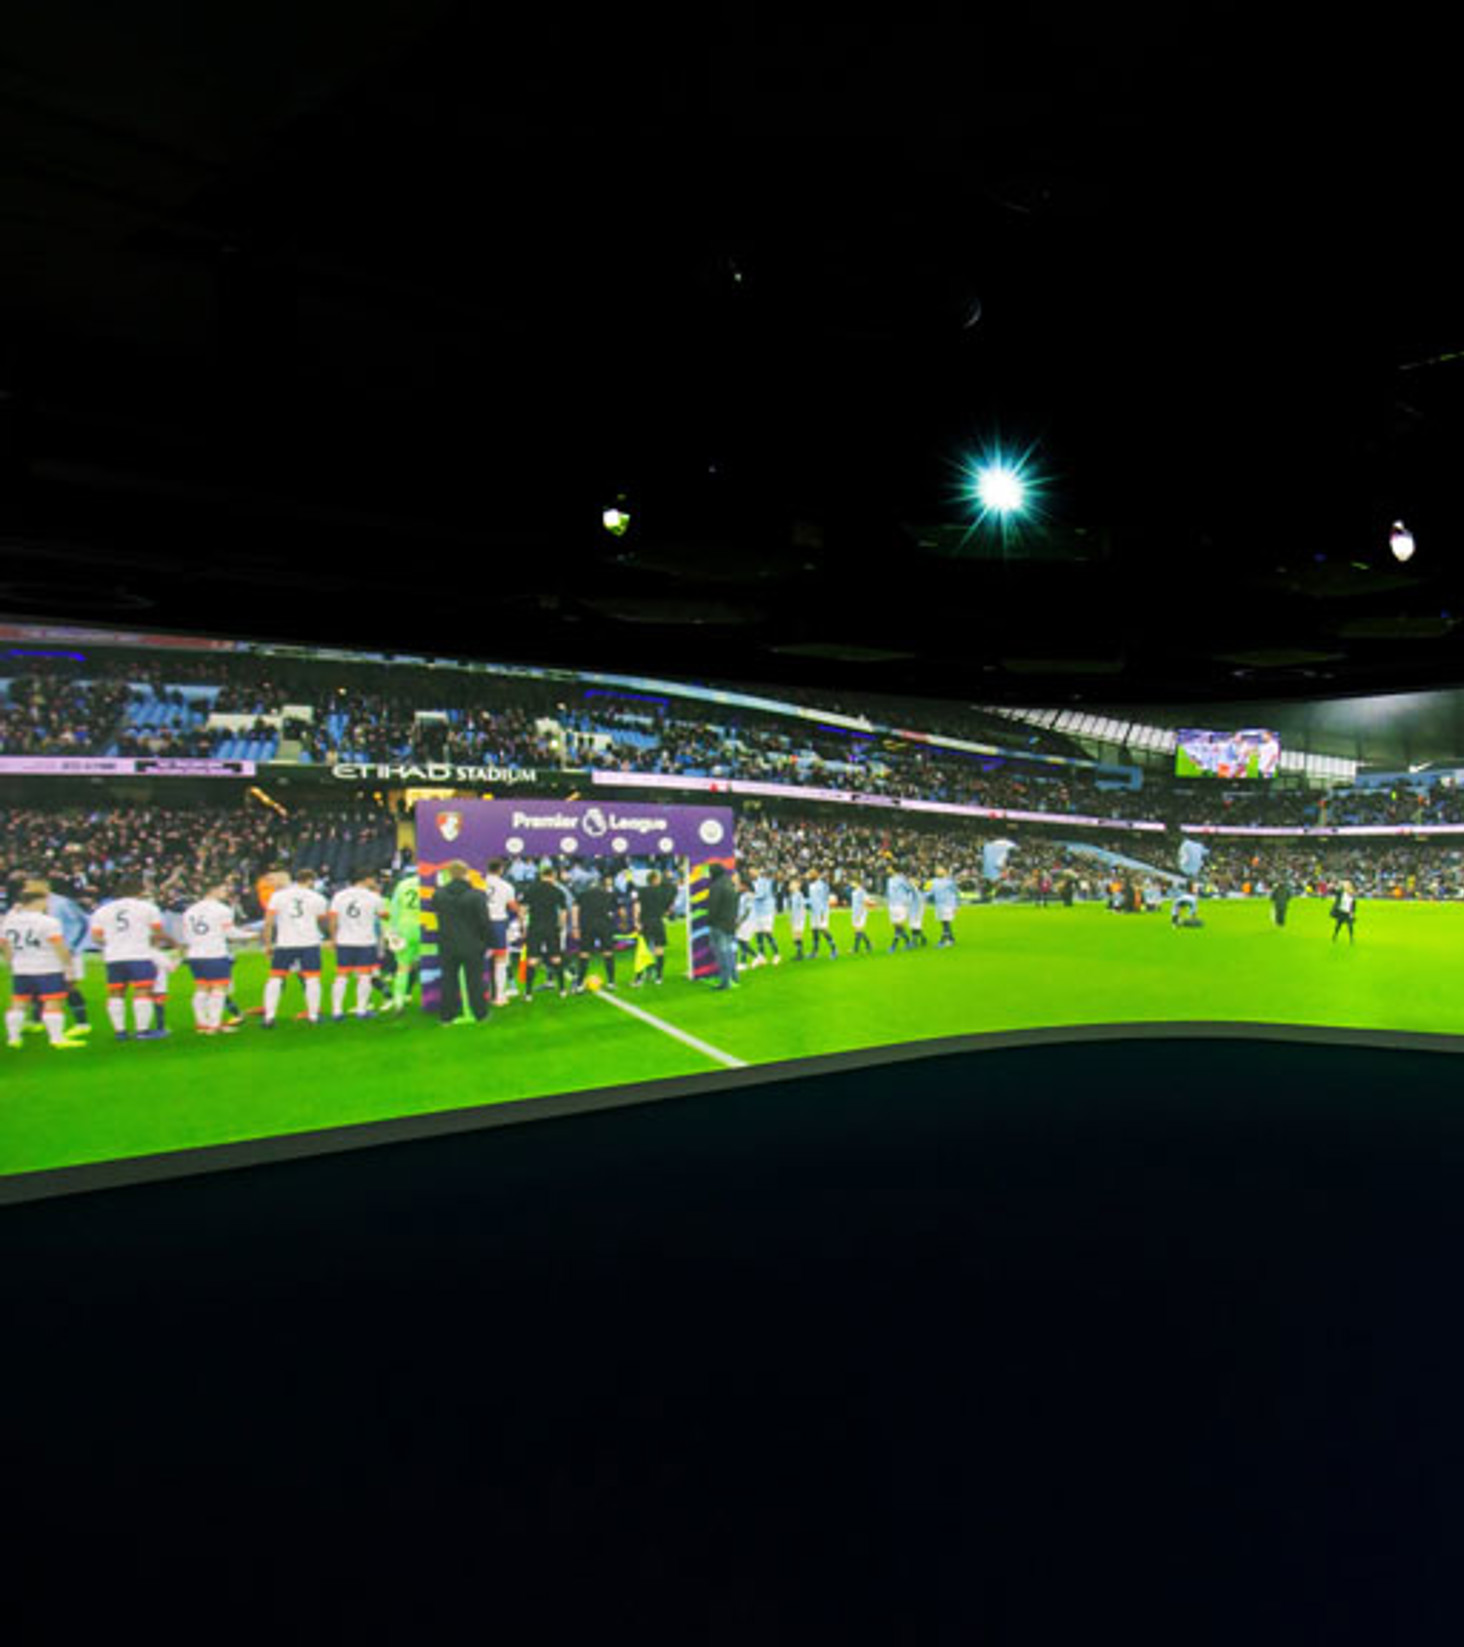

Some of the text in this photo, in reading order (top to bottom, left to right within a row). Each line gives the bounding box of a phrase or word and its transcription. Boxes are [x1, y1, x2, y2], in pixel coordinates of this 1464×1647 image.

[331, 763, 537, 783] ETIHAD STADIUM
[511, 811, 667, 833] Premier League
